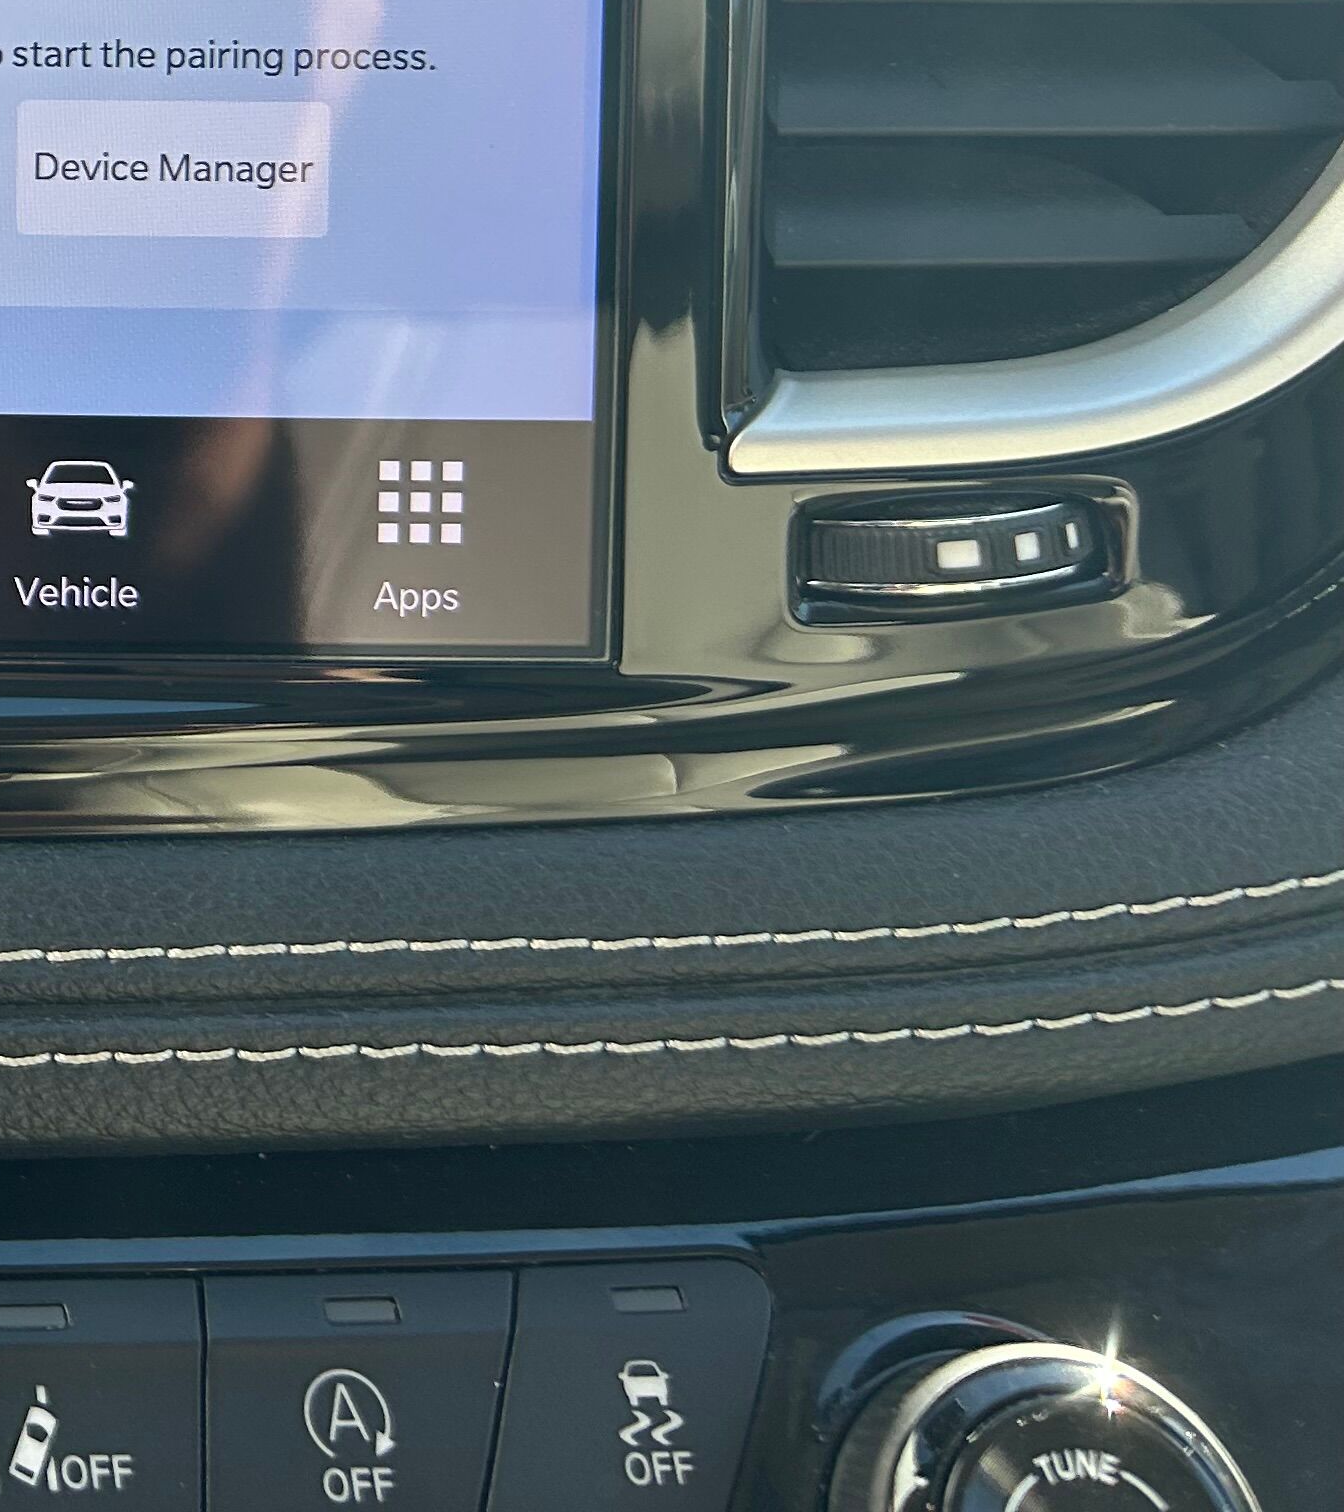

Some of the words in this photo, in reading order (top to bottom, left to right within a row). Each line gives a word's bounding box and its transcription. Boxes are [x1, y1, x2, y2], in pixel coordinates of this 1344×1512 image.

[12, 41, 92, 68] start
[99, 38, 156, 68] the
[166, 39, 284, 77] pairing
[293, 46, 436, 80] process.
[35, 151, 149, 181] Device
[159, 153, 314, 190] Manager
[13, 576, 138, 608] Vehicle
[373, 581, 459, 618] Apps
[61, 1454, 133, 1490] OFF
[323, 1467, 393, 1502] OFF
[625, 1451, 693, 1486] OFF
[1030, 1447, 1123, 1487] TUNE
